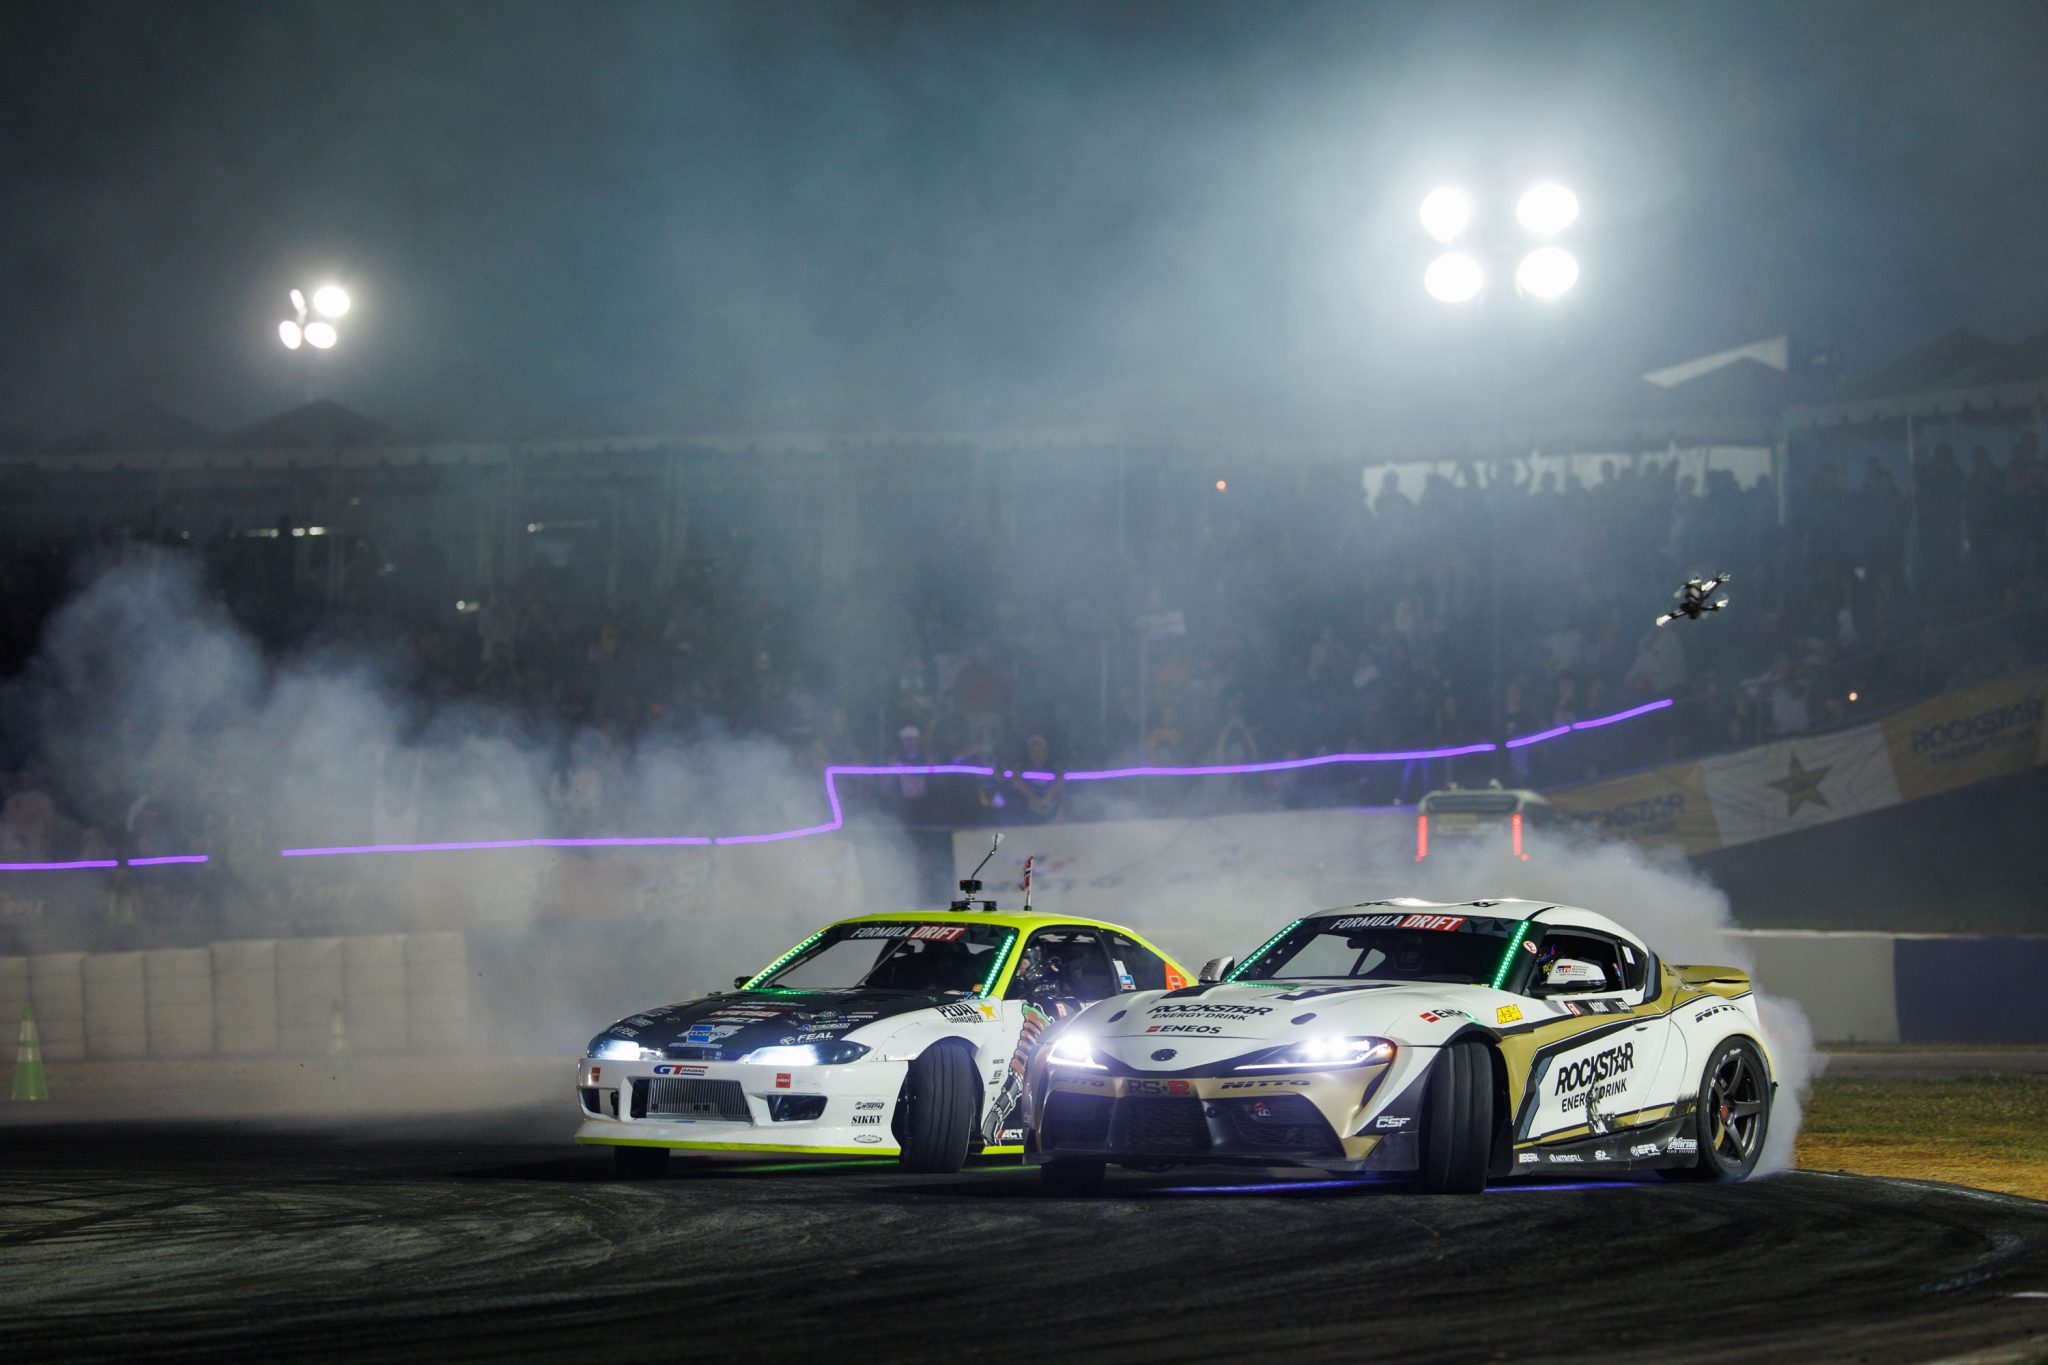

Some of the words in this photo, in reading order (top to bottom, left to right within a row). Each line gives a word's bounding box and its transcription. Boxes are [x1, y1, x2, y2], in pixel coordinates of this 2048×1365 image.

[1330, 915, 1404, 930] FORMULA
[1401, 914, 1464, 931] DRIFT
[850, 926, 915, 938] FORMULA
[911, 925, 965, 940] DRIFT
[936, 1003, 979, 1018] PEDAL
[1146, 1004, 1274, 1016] ROCKSTAR
[1151, 1012, 1204, 1020] ENERGY
[1208, 1012, 1248, 1021] DRINK
[1160, 1024, 1222, 1034] ENEOS
[797, 1031, 834, 1041] FEAL
[653, 1064, 684, 1076] GT
[1555, 1041, 1634, 1097] ROCKSTAR
[1220, 1079, 1312, 1090] NITTO
[851, 1114, 882, 1124] SIKKY
[1376, 1117, 1411, 1128] CSF
[1002, 1128, 1024, 1138] ACT
